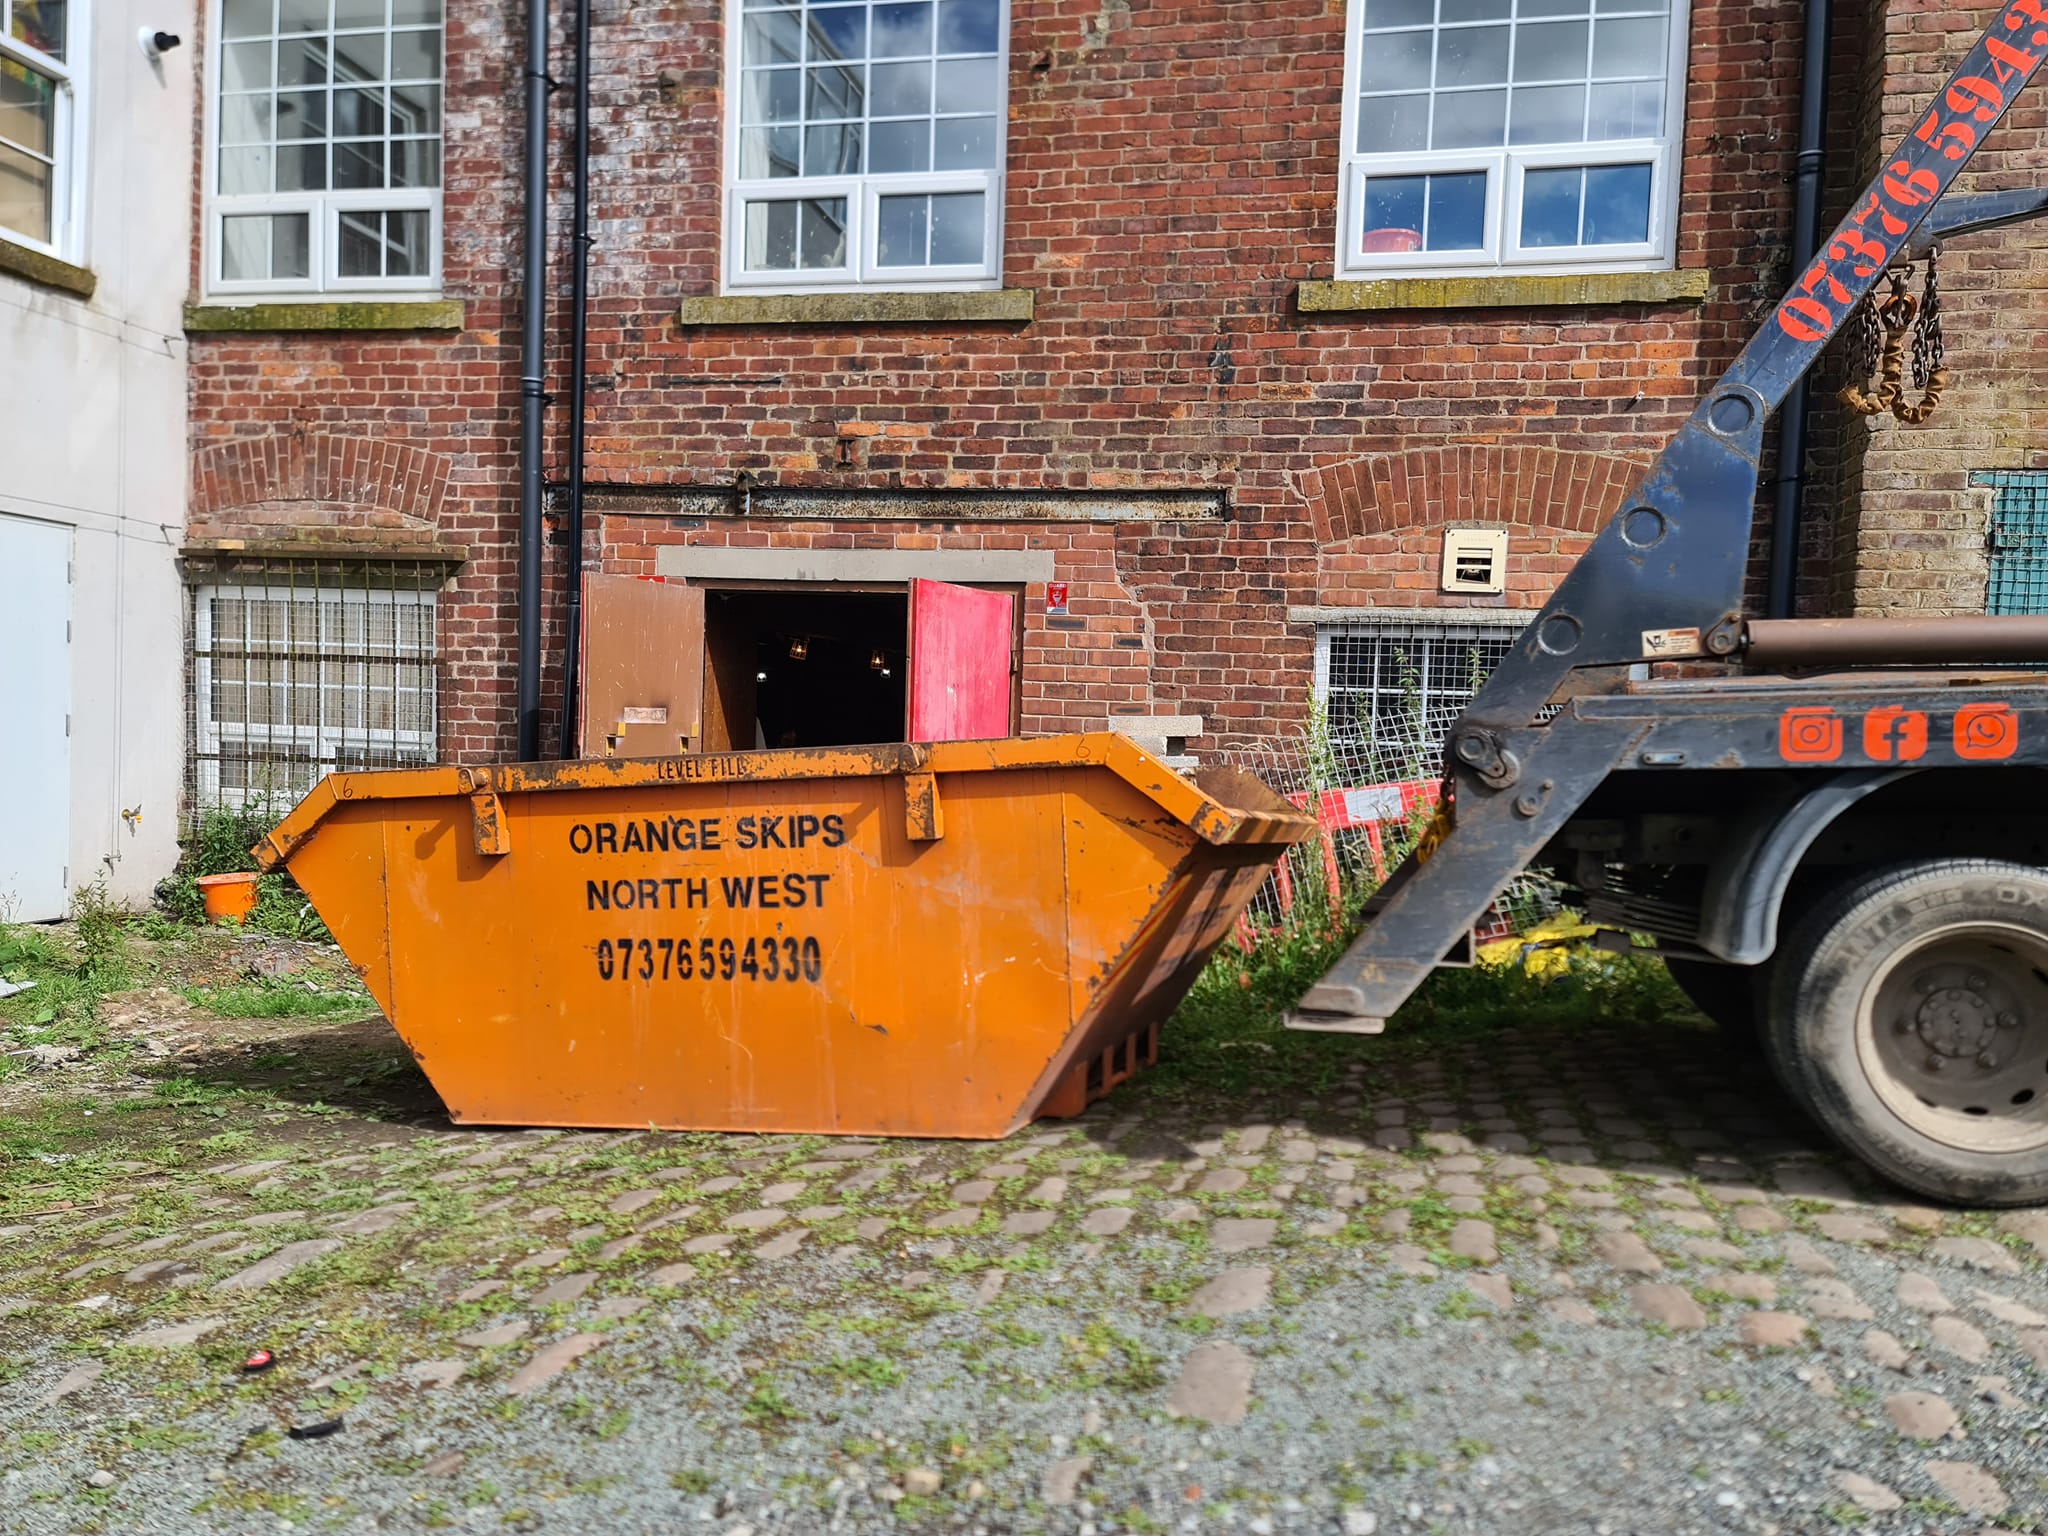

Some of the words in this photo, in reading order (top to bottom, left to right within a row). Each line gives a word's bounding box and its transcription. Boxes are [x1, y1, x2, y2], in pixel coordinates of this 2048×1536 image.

[1075, 737, 1092, 759] 6
[657, 759, 702, 779] LEVEL
[711, 757, 744, 777] FILL
[342, 777, 354, 799] 6
[569, 817, 722, 854] ORANGE
[735, 814, 846, 850] SKIPS
[586, 877, 709, 910] NORTH
[720, 873, 831, 908] WEST
[597, 936, 822, 982] 07376594330
